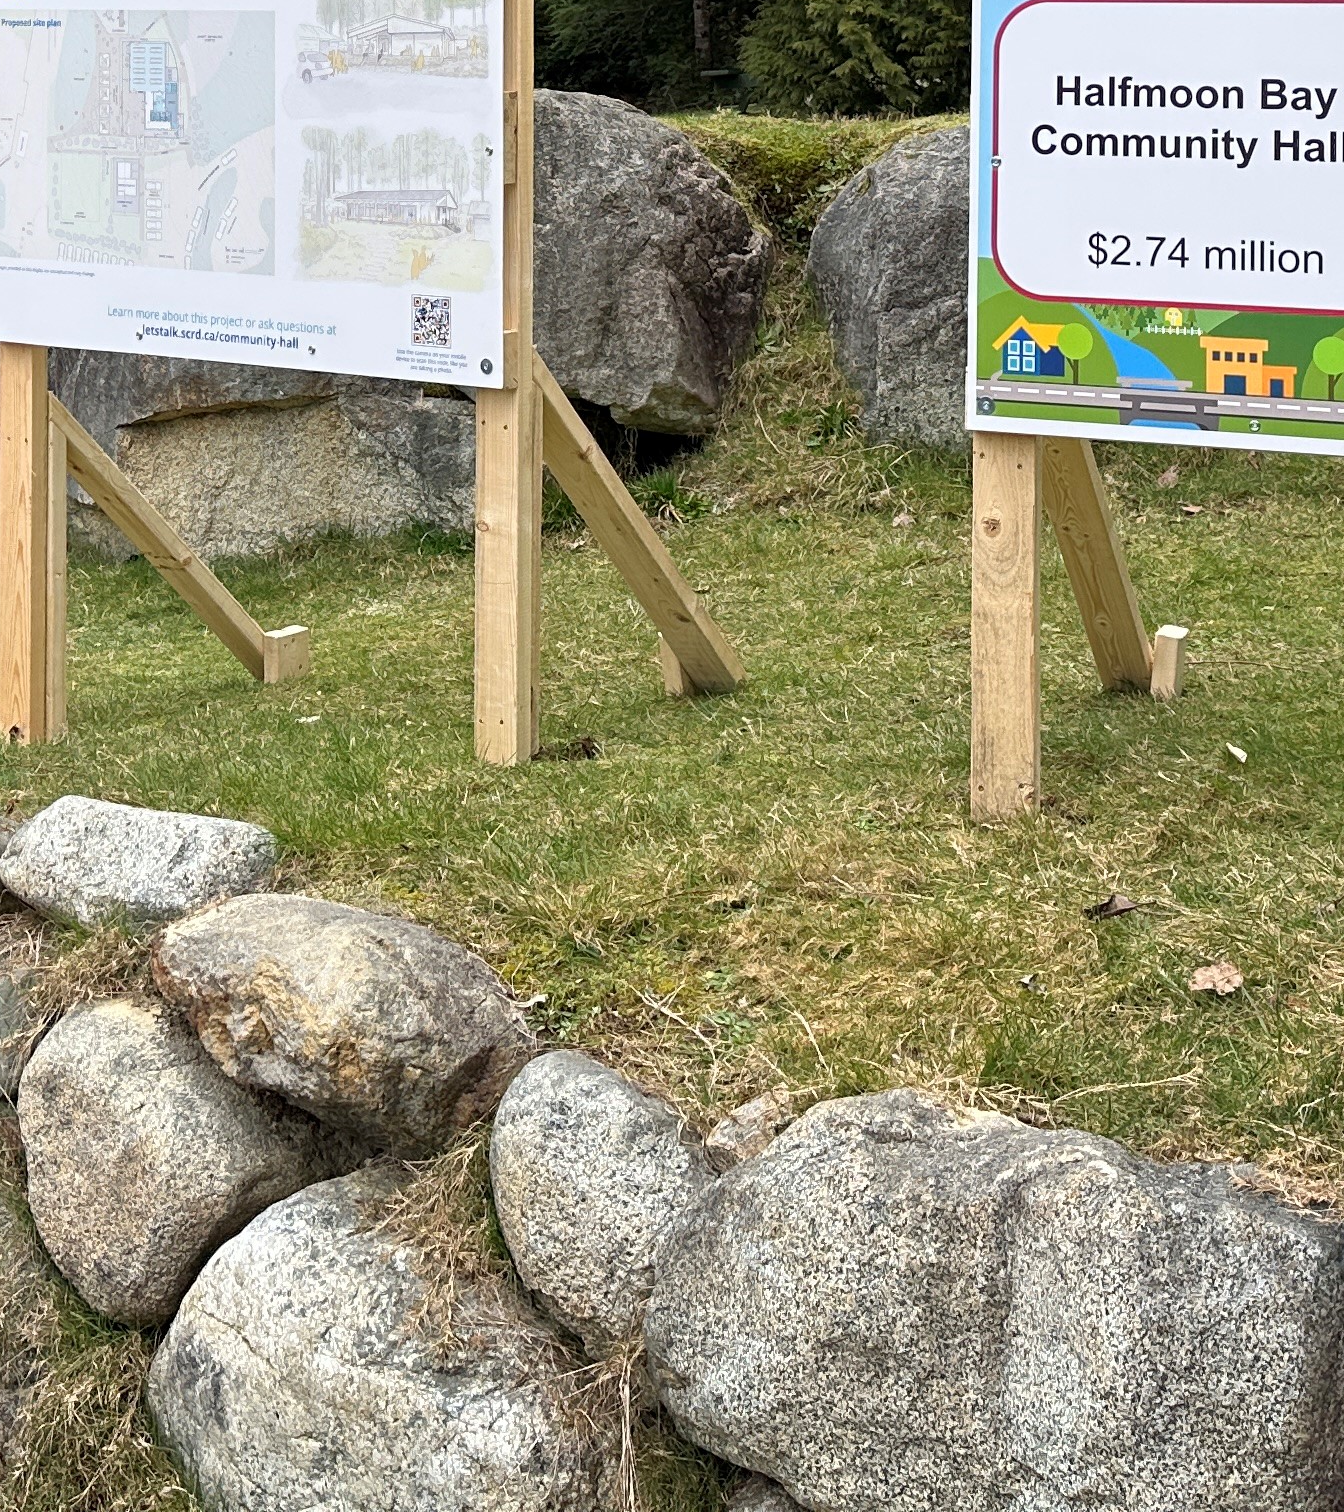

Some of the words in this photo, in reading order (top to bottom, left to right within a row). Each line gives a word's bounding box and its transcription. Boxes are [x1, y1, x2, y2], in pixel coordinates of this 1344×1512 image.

[1, 18, 32, 29] Proposed
[33, 18, 45, 27] site
[46, 18, 62, 29] plan
[1056, 75, 1244, 111] Halfmoon
[1260, 78, 1339, 120] Bay
[1031, 123, 1259, 169] Community
[1087, 231, 1190, 270] $2.74
[1204, 239, 1324, 275] million
[108, 306, 133, 318] Learn
[135, 309, 160, 320] more
[161, 310, 189, 323] about
[191, 312, 208, 324] this
[210, 315, 243, 329] project
[245, 318, 256, 328] or
[258, 318, 274, 330] ask
[276, 321, 324, 334] questions
[326, 325, 337, 336] at
[142, 324, 299, 350] letstalk.scrd.ca/community-hall
